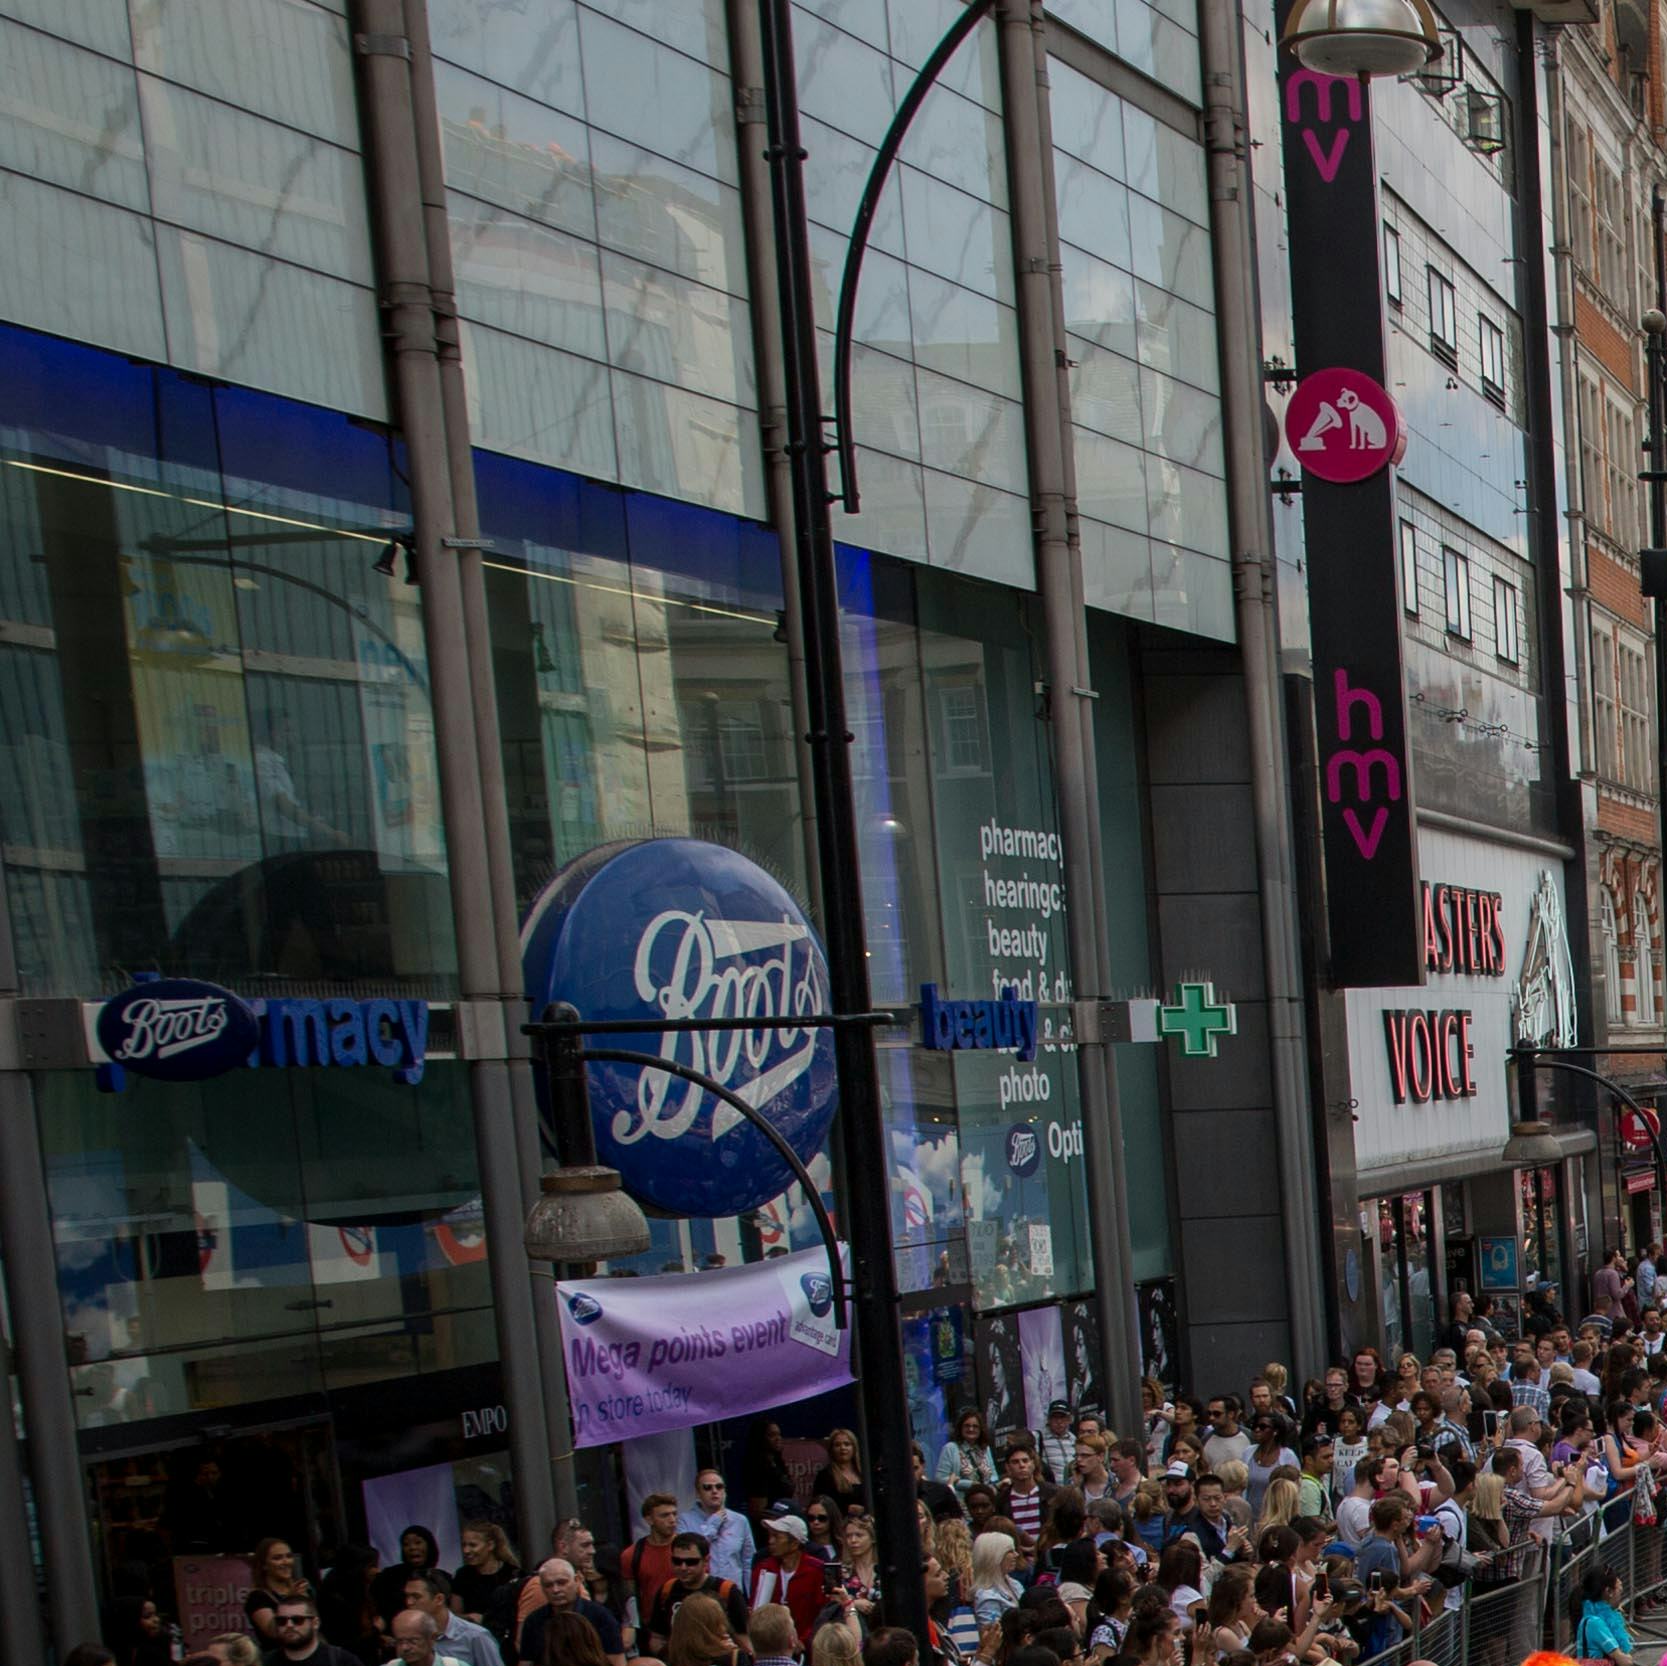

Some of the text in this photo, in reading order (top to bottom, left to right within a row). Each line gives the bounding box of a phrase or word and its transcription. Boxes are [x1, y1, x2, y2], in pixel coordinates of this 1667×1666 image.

[1328, 669, 1400, 860] hmv
[988, 919, 1047, 965] beauty
[115, 999, 228, 1058] Boots
[612, 910, 826, 1144] Boots
[1382, 1008, 1476, 1105] VOICE
[1000, 1066, 1050, 1110] photo
[571, 1311, 786, 1380] Mega points event
[597, 1385, 694, 1424] store today
[184, 1583, 247, 1606] triple
